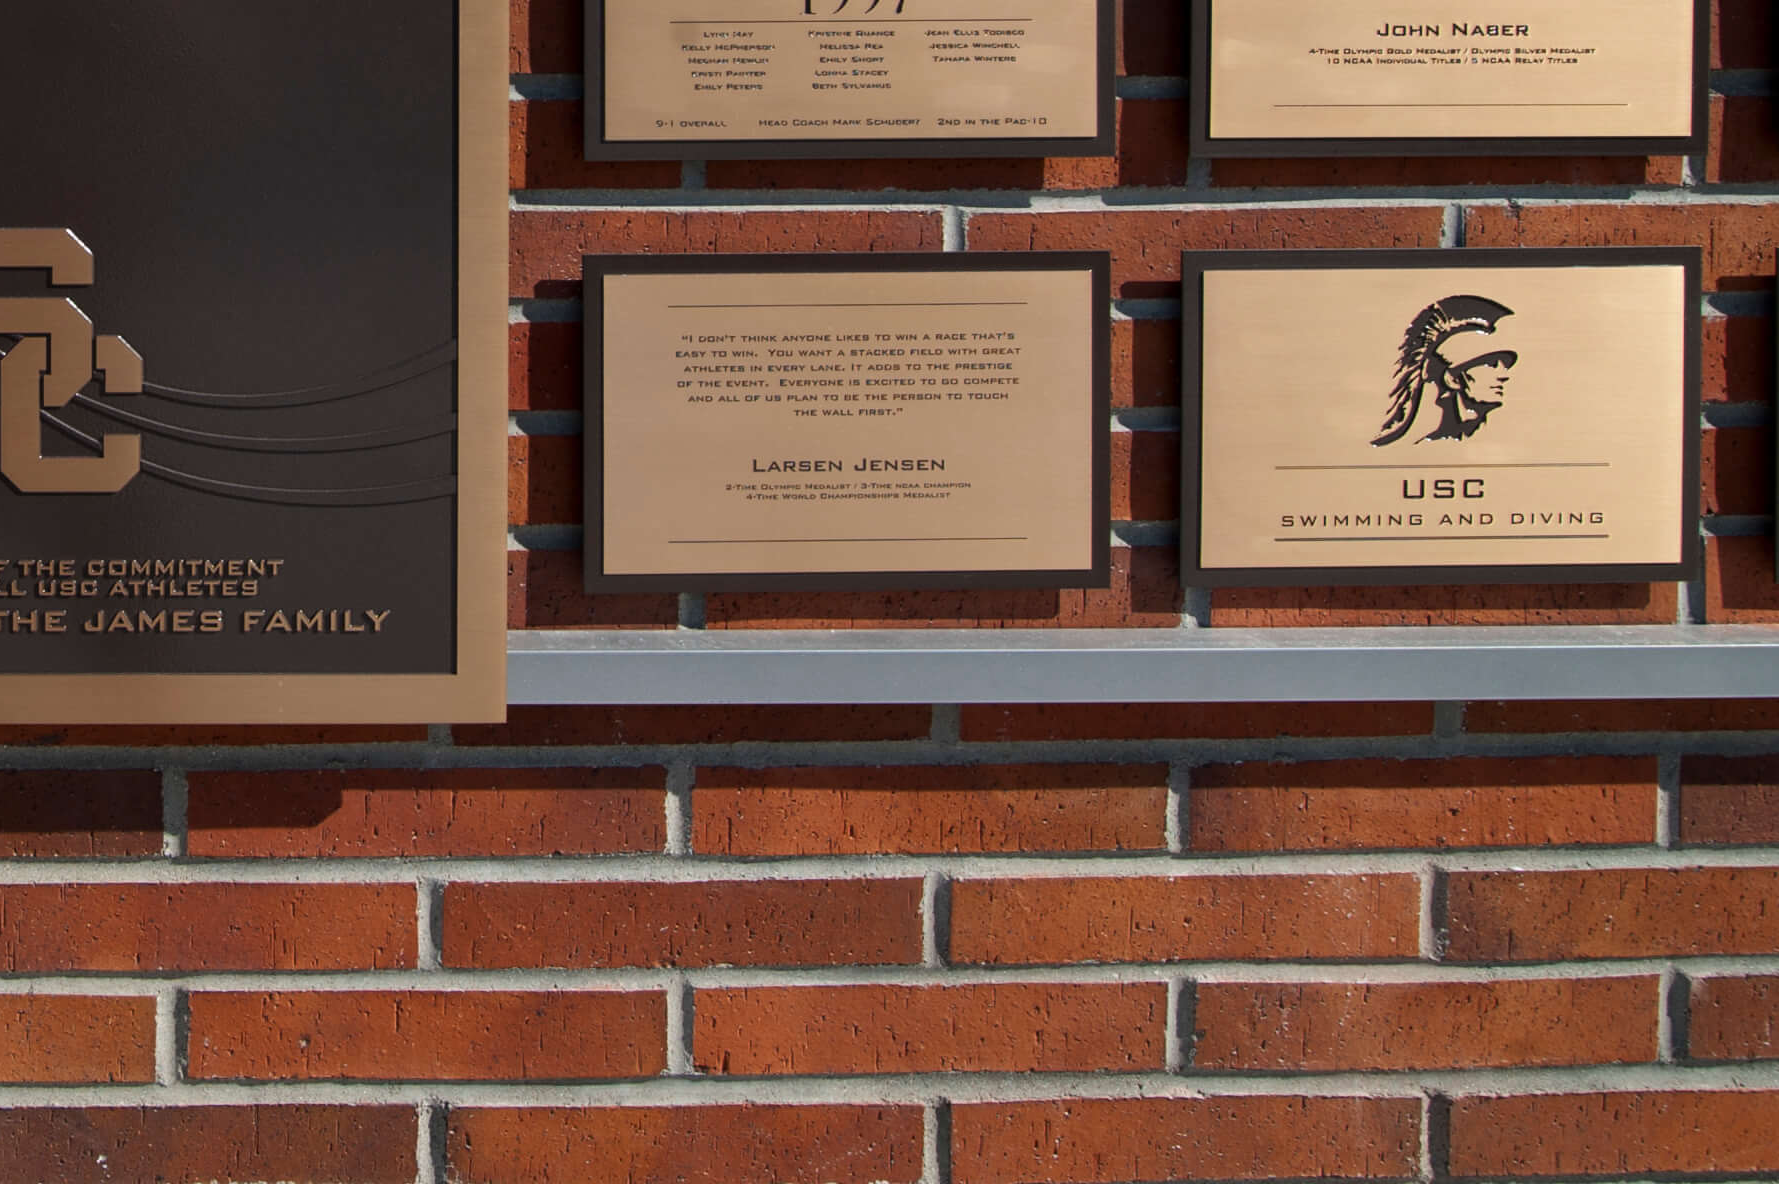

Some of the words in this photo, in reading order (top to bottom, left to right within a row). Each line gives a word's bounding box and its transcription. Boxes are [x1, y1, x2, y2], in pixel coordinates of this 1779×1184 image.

[1376, 22, 1440, 37] JOHN
[1451, 22, 1529, 37] NABER
[752, 458, 843, 473] LARSEN
[853, 457, 945, 472] JENSEN
[1402, 478, 1485, 500] USC
[1281, 513, 1423, 528] SWIMMING
[1438, 513, 1494, 526] AND
[1510, 512, 1604, 525] DIVING
[16, 558, 76, 578] THE
[87, 558, 284, 578] COMMITMENT
[38, 579, 99, 598] USC
[109, 579, 260, 598] ATHLETES
[84, 609, 224, 633] JAMES
[242, 609, 391, 633] FAMILY
